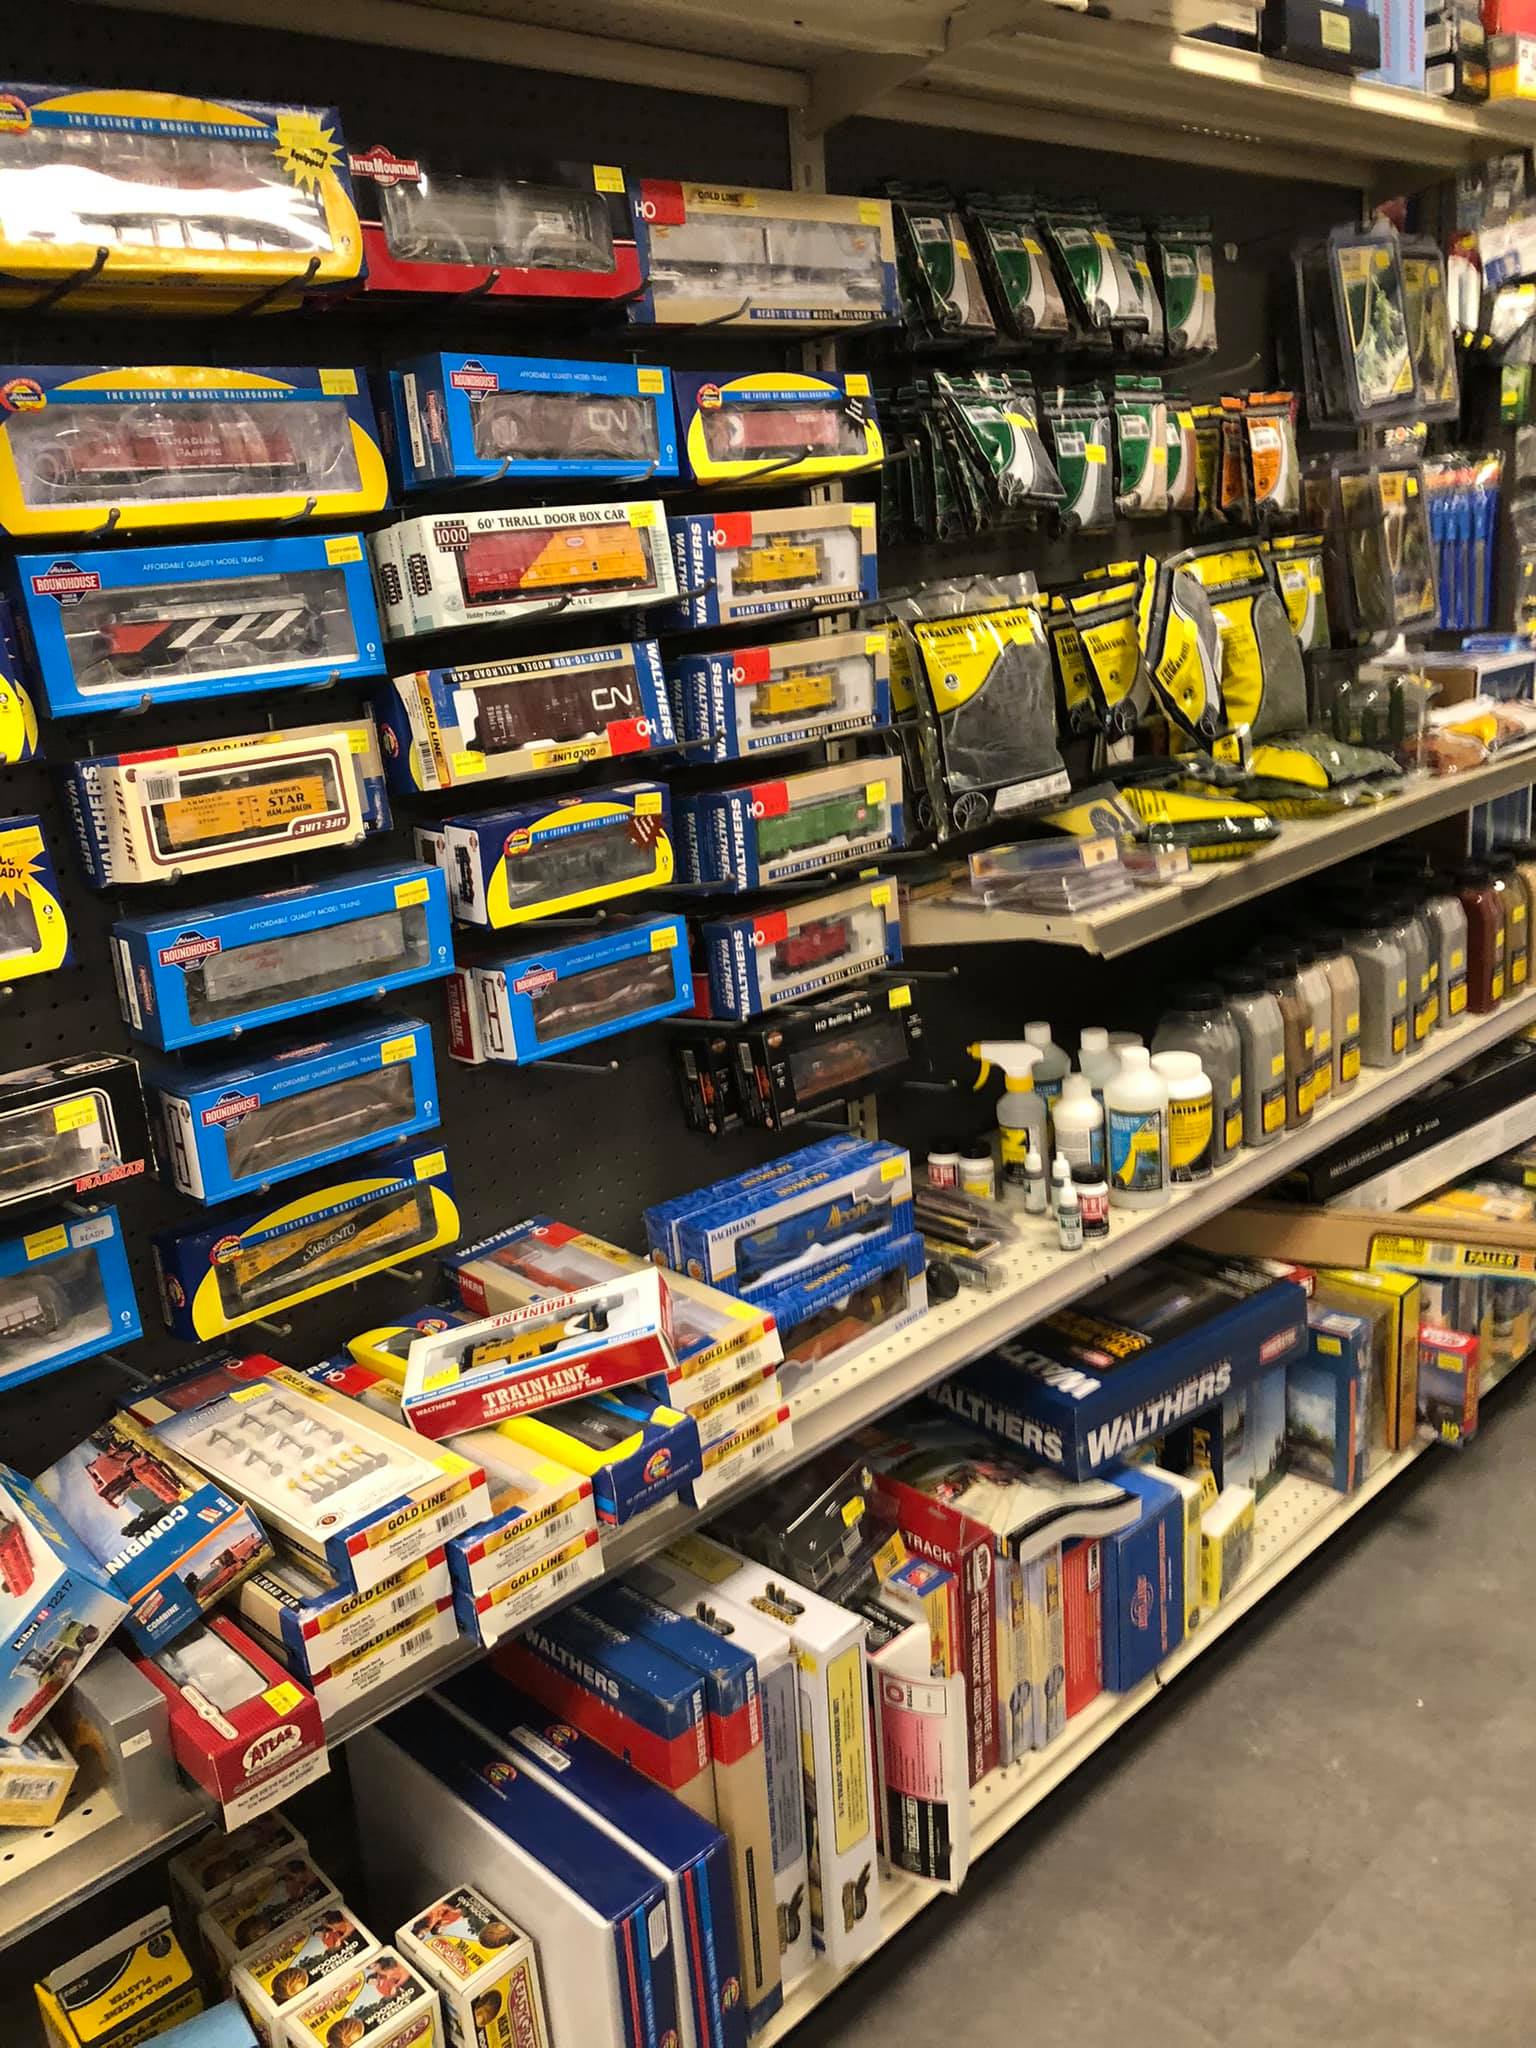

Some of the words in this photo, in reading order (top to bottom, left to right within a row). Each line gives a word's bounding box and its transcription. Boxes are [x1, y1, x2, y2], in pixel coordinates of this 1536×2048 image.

[68, 114, 88, 126] THE
[94, 116, 136, 129] FUTURE
[160, 122, 195, 135] MODEL
[634, 200, 656, 220] HO
[106, 390, 126, 401] THE
[129, 390, 167, 401] FUTURE
[170, 390, 185, 400] OF
[188, 390, 219, 401] MODEL
[453, 373, 496, 389] ROUNDHOUSE
[498, 515, 542, 529] THRALL
[544, 513, 577, 526] DOOR
[579, 511, 602, 523] BOX
[604, 509, 625, 521] CAR
[435, 528, 469, 546] 1000
[707, 529, 727, 547] HO
[143, 561, 184, 572] AFFORDABLE
[186, 559, 214, 569] QUALITY
[216, 558, 238, 566] MODEL
[691, 522, 707, 625] WATHERS
[36, 575, 97, 593] ROUNDHOUSE
[645, 639, 674, 741] WALTHERS
[727, 666, 745, 685] HO
[591, 684, 633, 711] CN
[423, 697, 436, 731] GOLD
[431, 731, 443, 757] LINE
[268, 792, 305, 807] STAR
[746, 800, 765, 819] HO
[294, 816, 347, 837] LIFE-LIKE
[731, 798, 747, 891] WALTHERS
[162, 939, 219, 964] ROUNDHOUSE
[748, 930, 765, 948] HO
[205, 1098, 258, 1123] ROUNDHOUSE
[75, 1160, 144, 1193] TRAINMAN
[303, 1222, 357, 1262] SARGENTO
[456, 1219, 535, 1257] WALTHERS
[711, 1217, 757, 1244] BACHMANN
[491, 1294, 577, 1329] TRAINLINE
[220, 1356, 243, 1369] HO
[697, 1342, 728, 1366] GOLD
[727, 1334, 748, 1354] LINE
[322, 1369, 346, 1382] HO
[482, 1364, 591, 1409] TRAINLINE
[415, 1399, 457, 1417] WALTHERS
[703, 1387, 731, 1411] GOLD
[1088, 1361, 1232, 1467] WALTHERS
[717, 1434, 743, 1458] GOLD
[742, 1424, 761, 1443] LINE
[388, 1504, 419, 1532] GOLD
[417, 1490, 447, 1517] LINE
[504, 1517, 533, 1540] GOLD
[532, 1503, 558, 1526] LINE
[904, 1531, 954, 1566] TRACK
[510, 1568, 540, 1591] GOLD
[539, 1551, 565, 1575] LINE
[47, 1578, 74, 1609] 12217
[280, 1591, 299, 1612] CAR
[341, 1588, 373, 1615] GOLD
[373, 1572, 404, 1598] LINE
[145, 1602, 181, 1633] COMBINE
[14, 1620, 39, 1652] kibri
[351, 1633, 383, 1658] GOLD
[382, 1616, 413, 1641] LINE
[524, 1627, 621, 1701] WALTHERS
[250, 1726, 295, 1768] ATLAS
[309, 1940, 359, 1976] WOODLAND
[365, 1987, 415, 2025] WOODLAND
